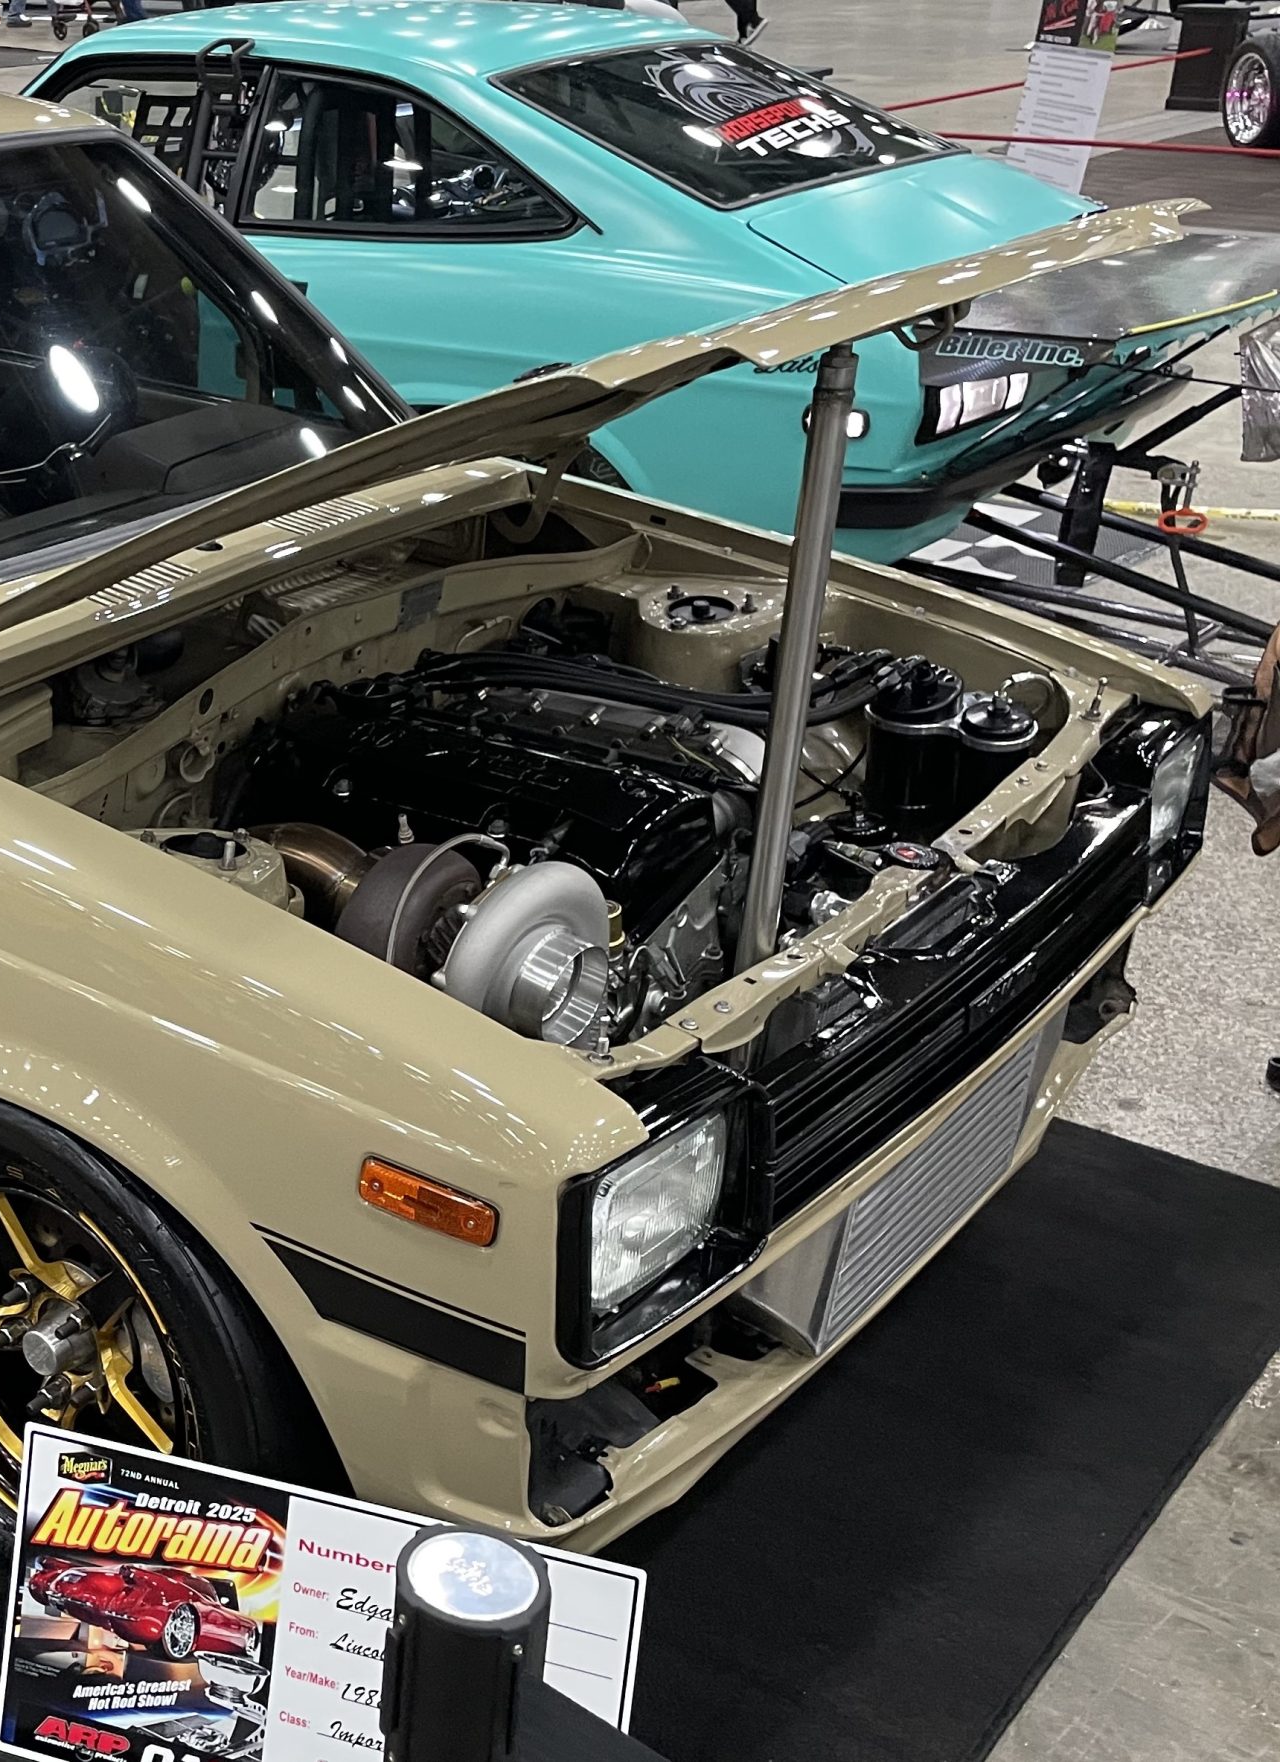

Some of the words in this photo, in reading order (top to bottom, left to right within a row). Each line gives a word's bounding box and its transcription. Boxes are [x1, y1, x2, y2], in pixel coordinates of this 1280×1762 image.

[736, 109, 851, 157] TECHS
[935, 335, 1019, 361] Billet
[1022, 340, 1084, 367] Inc.
[60, 1454, 109, 1480] Meguiar's
[120, 1468, 143, 1482] 72ND
[144, 1474, 181, 1491] ANNUAL
[135, 1491, 203, 1516] Detroit
[205, 1502, 258, 1523] 2025
[30, 1487, 275, 1572] Autorama
[298, 1538, 396, 1573] Number
[293, 1582, 330, 1601] Owner:
[336, 1587, 394, 1621] Edga
[288, 1621, 319, 1639] From:
[329, 1633, 384, 1662] Linco
[72, 1682, 137, 1699] America's
[136, 1679, 193, 1694] Greatest
[87, 1697, 111, 1711] Hot
[111, 1695, 137, 1709] Rod
[137, 1693, 178, 1708] Show!
[284, 1665, 340, 1690] Year/Make:
[341, 1683, 381, 1708] 198
[34, 1715, 131, 1755] ARP
[278, 1710, 311, 1729] Class:
[330, 1720, 384, 1751] Impor
